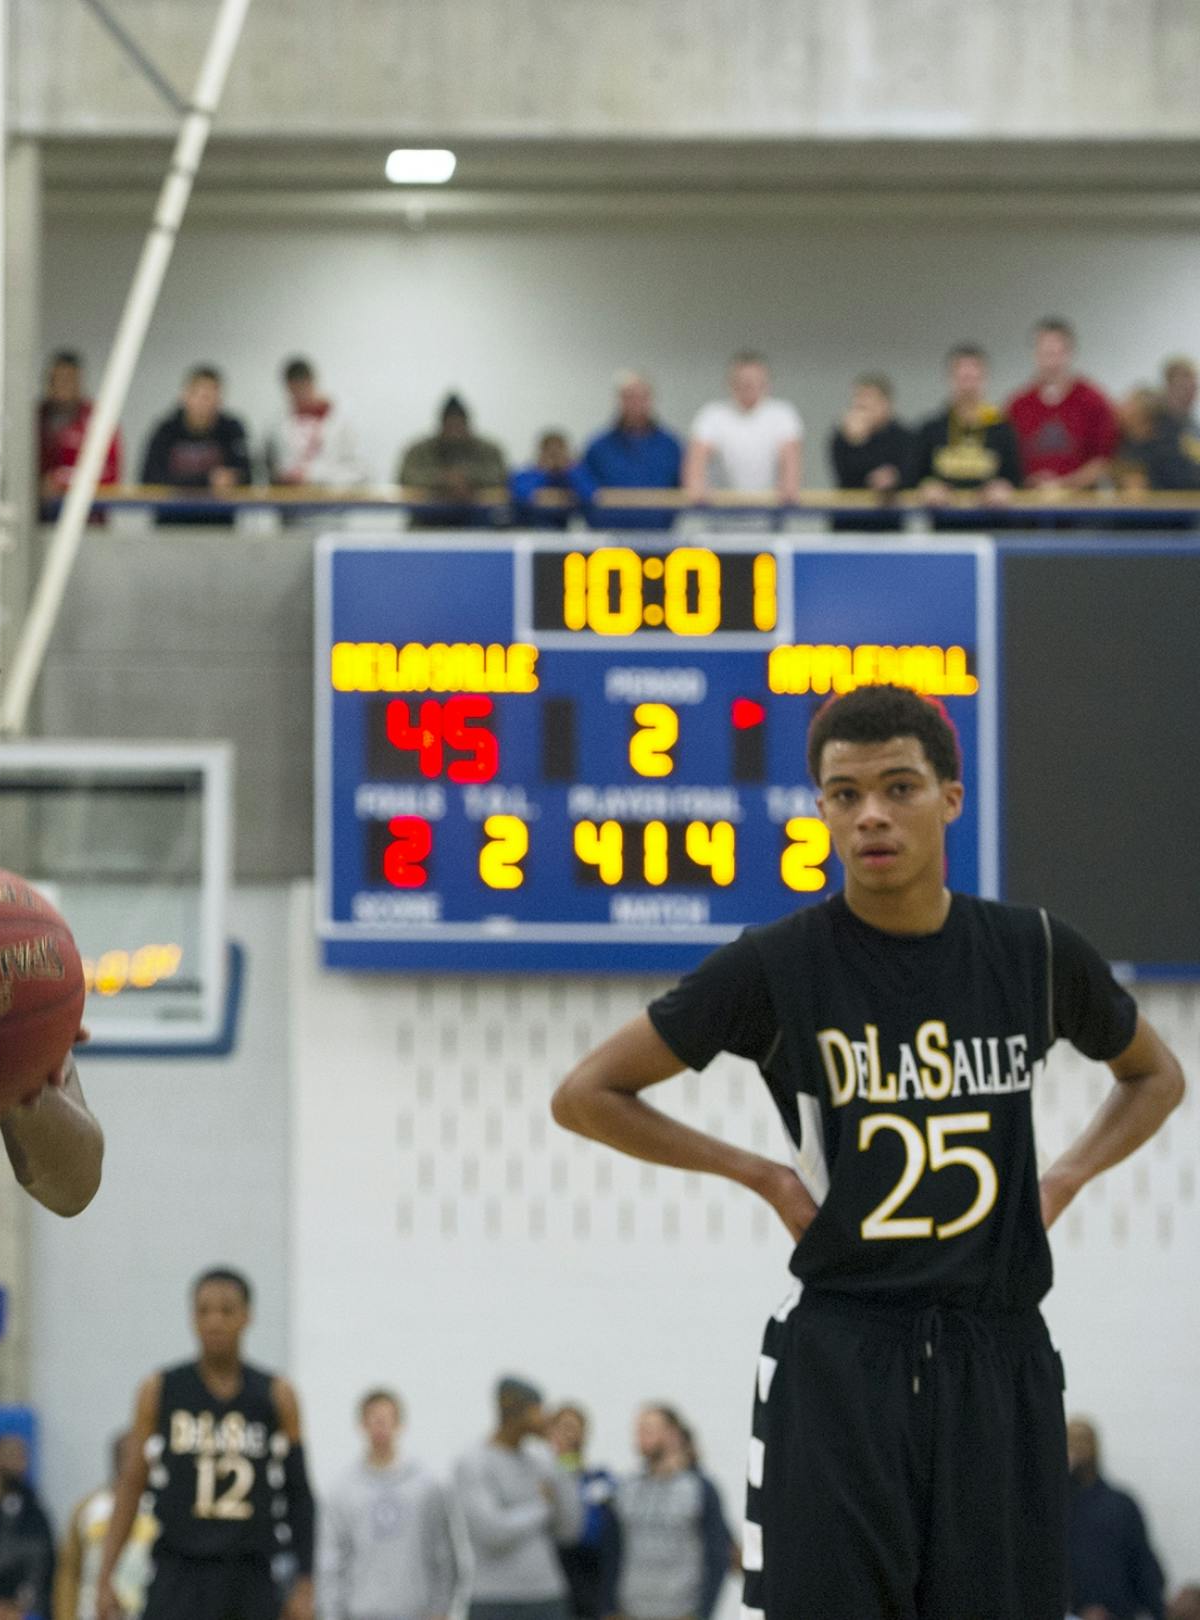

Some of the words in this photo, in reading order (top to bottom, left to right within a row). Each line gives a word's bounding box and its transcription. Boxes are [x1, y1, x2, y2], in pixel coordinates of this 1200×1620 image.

[563, 546, 777, 636] 10:01
[385, 693, 500, 784] 45
[628, 702, 680, 778] 2
[383, 814, 433, 890] 2
[478, 813, 530, 890] 2
[780, 816, 831, 893] 2
[858, 1111, 999, 1240] 25
[192, 1454, 256, 1521] 12
